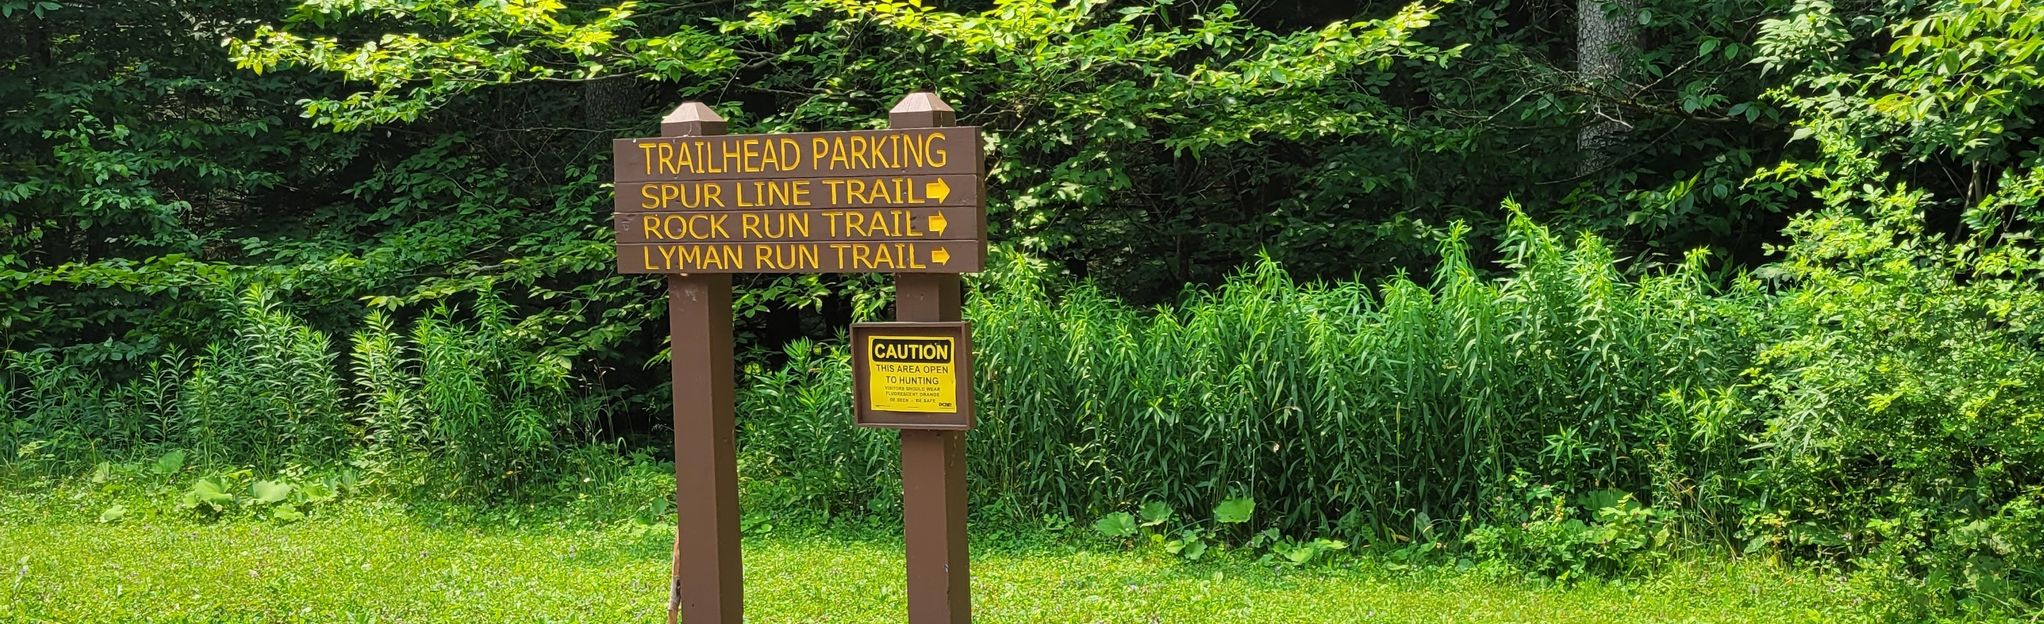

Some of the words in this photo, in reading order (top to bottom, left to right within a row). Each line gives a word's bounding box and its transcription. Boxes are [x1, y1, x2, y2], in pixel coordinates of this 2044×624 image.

[639, 137, 801, 176] TRAILHEAD
[811, 132, 947, 171] PARKING
[641, 181, 725, 210] SPUR
[736, 180, 811, 207] LINE
[822, 177, 925, 206] TRAIL
[643, 213, 729, 241] ROCK
[742, 212, 809, 239] RUN
[821, 210, 923, 238] TRAIL
[643, 244, 742, 271] LYMAN
[755, 243, 818, 270] RUN
[830, 243, 926, 269] TRAIL
[874, 343, 948, 360] CAUTION
[876, 364, 895, 373] THIS
[897, 365, 921, 374] AREA
[923, 365, 949, 374] OPEN
[886, 375, 897, 384] TO
[899, 376, 939, 385] HUNTING
